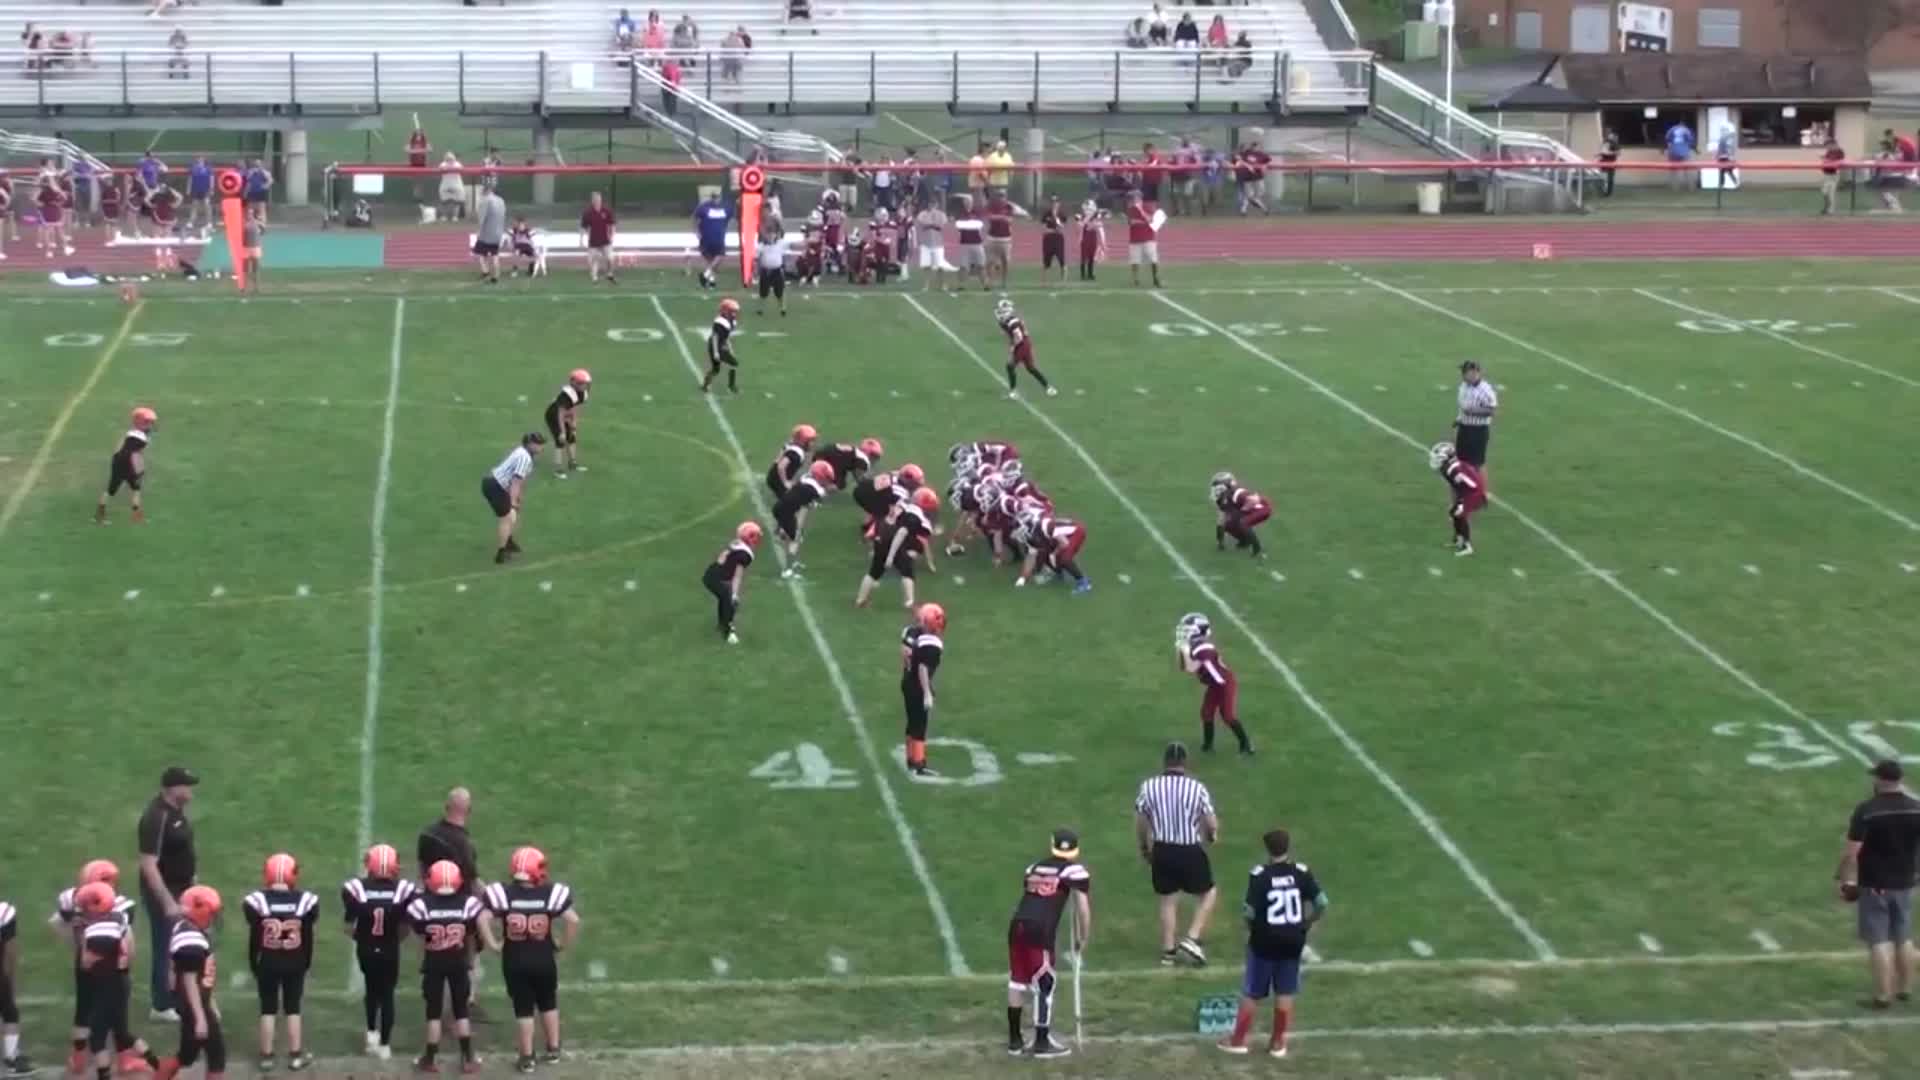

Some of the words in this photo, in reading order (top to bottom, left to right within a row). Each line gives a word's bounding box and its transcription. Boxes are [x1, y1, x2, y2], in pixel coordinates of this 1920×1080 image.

[750, 737, 1004, 789] 40
[371, 907, 385, 936] 1
[1266, 888, 1302, 924] 20
[262, 918, 302, 950] 23
